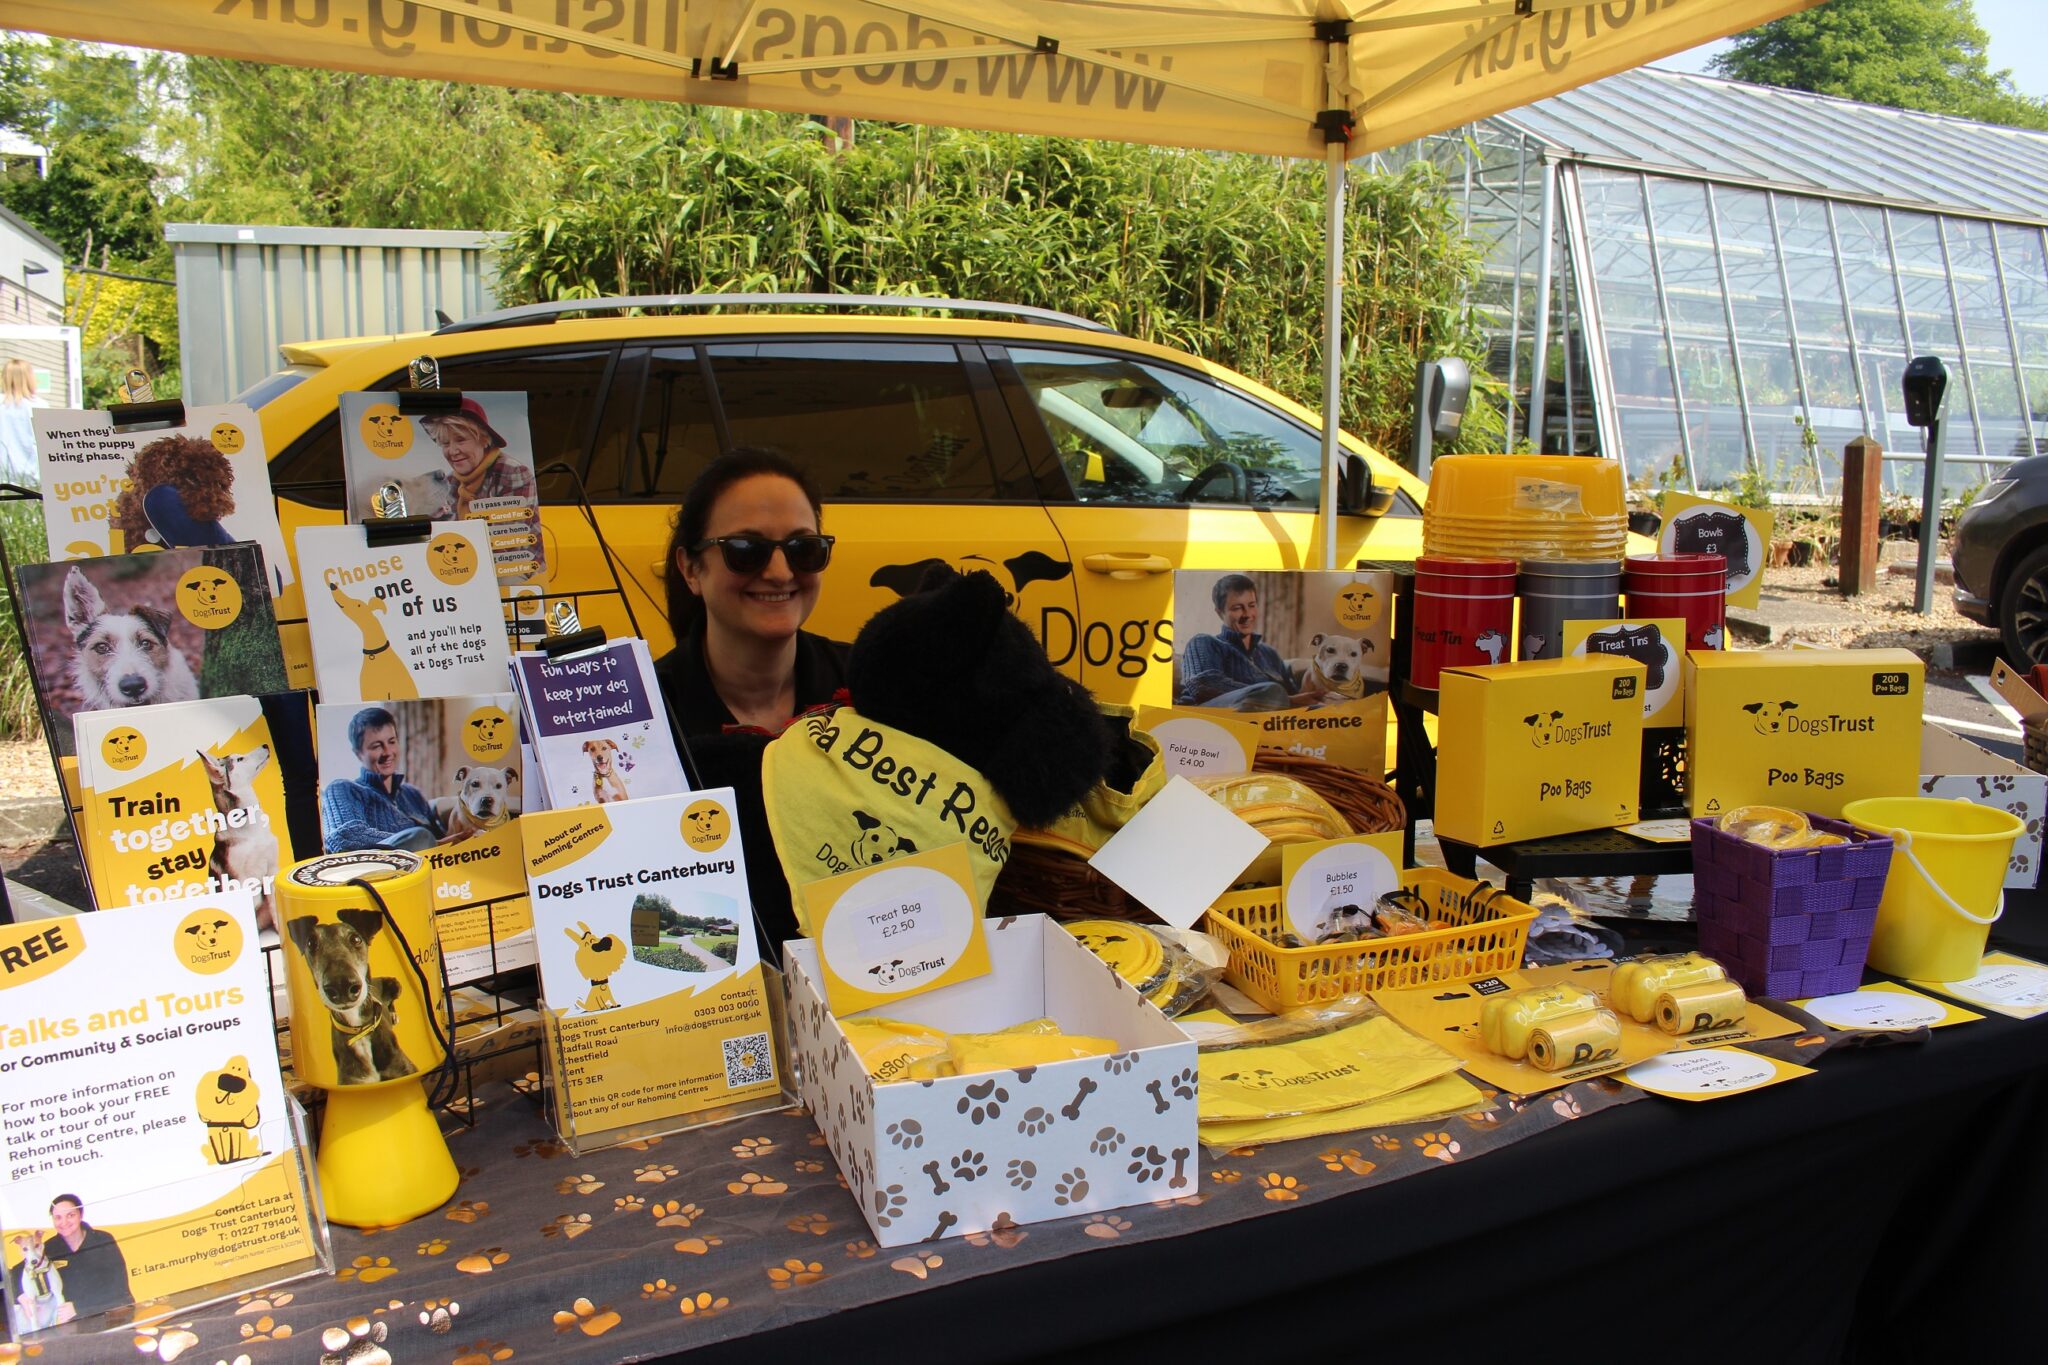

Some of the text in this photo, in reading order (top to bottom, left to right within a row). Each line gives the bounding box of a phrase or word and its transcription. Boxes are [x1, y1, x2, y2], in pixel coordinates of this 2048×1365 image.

[46, 429, 80, 440] When
[62, 440, 135, 450] in the puppy
[372, 440, 404, 449] DogsTrust
[48, 452, 125, 463] biting phase,
[53, 474, 135, 502] you're
[70, 498, 121, 523] not
[484, 500, 521, 510] pass away
[1698, 527, 1724, 538] Bowls
[498, 552, 530, 564] diagnosis
[1706, 544, 1717, 554] £3
[323, 555, 404, 588] Choose
[440, 566, 470, 578] DogsTrust
[374, 578, 414, 601] one
[192, 606, 232, 618] DogsTrust
[402, 595, 458, 617] of us
[1342, 612, 1372, 622] DogsTrust
[408, 624, 482, 642] and you'll help
[1041, 606, 1174, 679] Dogs
[1598, 636, 1649, 652] Treat Tins
[410, 637, 487, 656] all of the dogs
[414, 652, 485, 671] at Dogs Trust
[566, 660, 600, 676] ways
[602, 656, 617, 673] to
[1618, 678, 1631, 688] 200
[1875, 684, 1906, 694] Poo Bags
[1882, 674, 1900, 684] 200
[544, 680, 629, 703] keep your dog
[552, 700, 633, 728] entertained!
[1263, 714, 1363, 732] difference
[1555, 720, 1612, 745] DogsTrust
[1788, 714, 1875, 737] DogsTrust
[112, 754, 139, 764] DogsTrust
[472, 743, 503, 753] DogsTrust
[1170, 744, 1220, 760] Fold up Bowl
[816, 726, 840, 753] a
[842, 727, 937, 806] Best
[1179, 758, 1206, 768] £4.00
[1540, 778, 1592, 801] Poo Bags
[1768, 768, 1845, 790] Poo Bags
[108, 792, 181, 818] Train
[110, 804, 270, 854] together,
[543, 821, 583, 848] About our
[692, 832, 722, 844] DogsTrust
[531, 823, 605, 868] Rehoming Centres
[147, 848, 208, 881] stay
[424, 845, 500, 870] fference
[537, 859, 736, 900] Dogs Trust Canterbury
[1326, 872, 1358, 883] Bubbles
[436, 880, 473, 900] dog
[868, 902, 922, 926] Treat Bag
[882, 918, 916, 938] £2.50
[0, 926, 69, 974] REE
[191, 950, 231, 964] DogsTrust
[898, 956, 946, 978] DogsTrust
[720, 988, 758, 1001] Contact:
[1474, 979, 1500, 990] 2x20
[87, 998, 150, 1033] and
[156, 986, 244, 1018] Tours
[694, 998, 760, 1018] 0303 003 0000
[555, 1018, 660, 1044] Dogs Trust Canterbury
[665, 1010, 762, 1034] info@dogstrust.org.uk
[0, 1015, 242, 1073] or Community & Social Groups
[595, 1036, 618, 1048] Road
[558, 1050, 609, 1066] Chestfield
[586, 1074, 604, 1085] 3ER
[1271, 1064, 1361, 1088] DogsTrust
[0, 1069, 176, 1114] For more information on
[564, 1072, 724, 1110] Scan this QR code for more information
[594, 1106, 610, 1116] any
[611, 1101, 620, 1110] of
[621, 1100, 636, 1108] our
[636, 1089, 677, 1106] Rehoming
[678, 1084, 710, 1098] Centres
[3, 1085, 171, 1130] how to book your FREE
[6, 1109, 137, 1146] talk or tour of our
[8, 1114, 187, 1162] Rehoming Centre, please
[10, 1149, 104, 1180] get in touch.
[215, 1192, 294, 1216] Contact Lara at
[181, 1204, 296, 1239] Dogs Trust Canterbury
[218, 1214, 298, 1241] T: 01227 791404
[130, 1267, 142, 1277] E:
[144, 1226, 301, 1274] lara.murphy@dogstrust.org.uk
